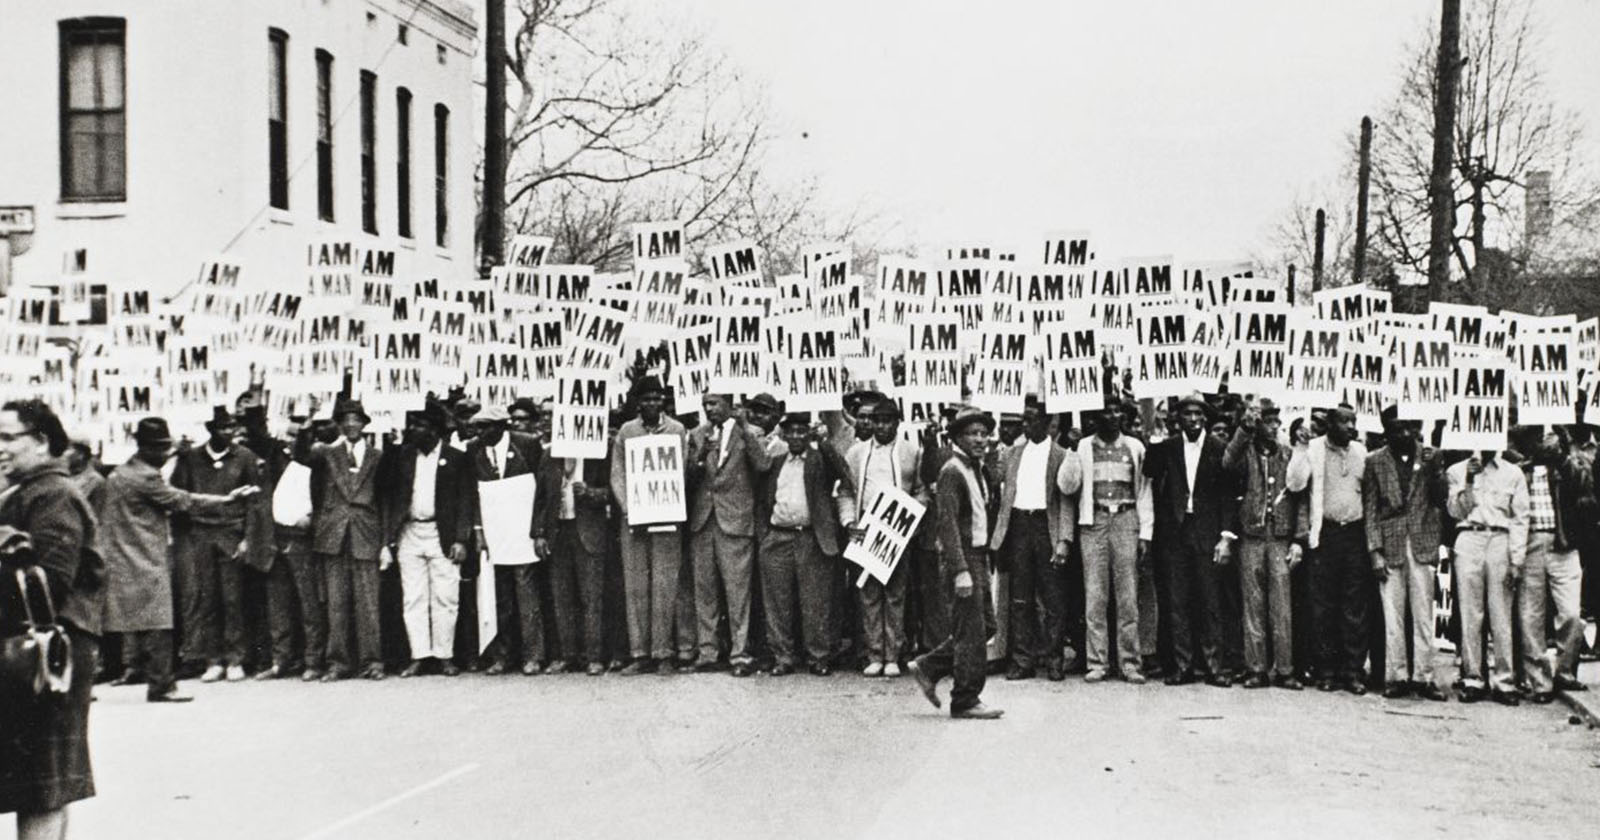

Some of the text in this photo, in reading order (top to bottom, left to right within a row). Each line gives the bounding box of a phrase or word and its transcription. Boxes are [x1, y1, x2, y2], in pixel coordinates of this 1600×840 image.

[308, 243, 351, 266] I AM
[510, 244, 545, 266] I AM
[638, 230, 680, 257] I AM
[1045, 240, 1087, 265] I AM
[208, 263, 240, 287] AM
[362, 250, 394, 276] AM
[712, 248, 756, 278] I AM
[821, 262, 846, 289] AM
[323, 275, 351, 294] MAN
[515, 273, 539, 296] MAN
[547, 275, 589, 300] I AM
[637, 271, 683, 294] I AM
[882, 266, 926, 295] I AM
[938, 269, 981, 296] I AM
[1017, 275, 1063, 301] I AM
[1092, 271, 1097, 294] I
[1124, 266, 1170, 294] I AM
[122, 291, 149, 314] AM
[267, 293, 301, 320] AM
[362, 283, 392, 306] MAN
[821, 294, 845, 318] MAN
[1331, 294, 1362, 321] AM
[19, 299, 44, 324] AM
[647, 301, 676, 325] MAN
[878, 298, 885, 322] A
[310, 316, 340, 342] AM
[430, 311, 464, 336] AM
[520, 325, 524, 348] I
[531, 322, 561, 348] AM
[577, 314, 624, 346] I AM
[716, 317, 720, 342] I
[726, 316, 759, 343] AM
[1137, 315, 1185, 345] I AM
[1235, 313, 1286, 342] I AM
[1445, 316, 1481, 344] AM
[375, 334, 378, 359] I
[385, 333, 420, 359] AM
[788, 333, 792, 359] I
[800, 331, 835, 358] AM
[910, 324, 956, 350] I AM
[990, 334, 1025, 360] AM
[1047, 330, 1095, 360] I AM
[1289, 330, 1338, 357] I AM
[179, 346, 208, 371] AM
[313, 350, 338, 374] MAN
[431, 343, 461, 368] MAN
[476, 354, 517, 377] I AM
[568, 346, 612, 369] A MAN
[673, 342, 678, 365] I
[715, 352, 759, 377] A MAN
[1140, 352, 1187, 380] A MAN
[1234, 350, 1284, 378] A MAN
[1402, 342, 1449, 367] I AM
[1520, 344, 1525, 370] I
[1531, 345, 1567, 371] AM
[522, 358, 529, 380] A
[910, 360, 918, 385] A
[926, 360, 957, 385] MAN
[1287, 365, 1337, 392] A MAN
[1342, 352, 1348, 378] I
[1352, 354, 1382, 382] AM
[390, 369, 420, 392] MAN
[559, 378, 606, 406] I AM
[679, 374, 686, 397] A
[790, 367, 836, 394] A MAN
[978, 369, 1023, 396] A MAN
[1050, 367, 1098, 395] A MAN
[1403, 377, 1410, 403] A
[1453, 369, 1504, 396] I AM
[119, 387, 150, 411] AM
[1356, 388, 1382, 416] MAN
[1523, 381, 1569, 407] A MAN
[558, 414, 604, 440] A MAN
[1452, 406, 1503, 432] A MAN
[631, 447, 677, 473] I AM
[634, 480, 680, 507] A MAN
[871, 492, 916, 537] I AM
[869, 531, 900, 568] MAN
